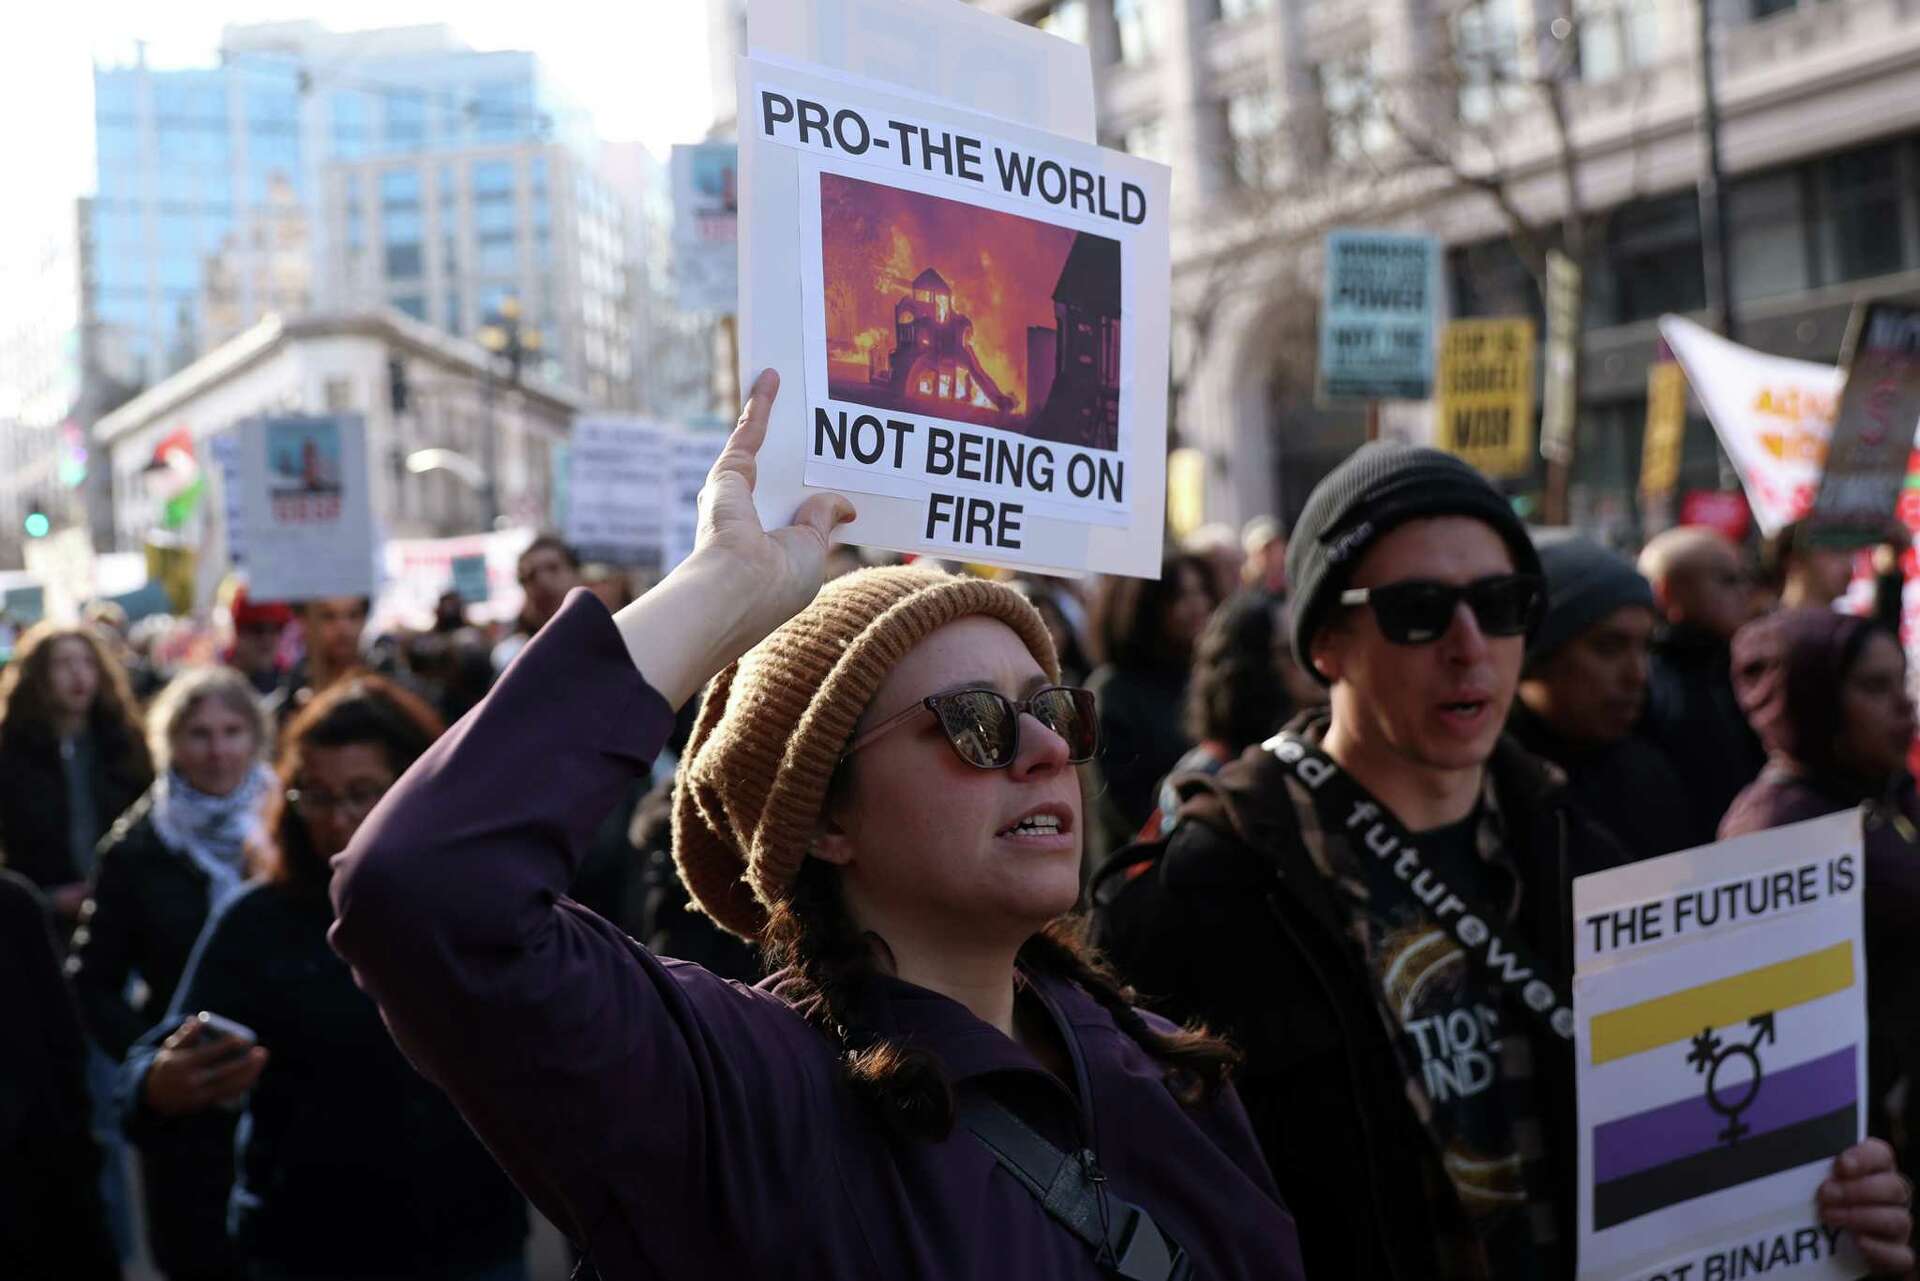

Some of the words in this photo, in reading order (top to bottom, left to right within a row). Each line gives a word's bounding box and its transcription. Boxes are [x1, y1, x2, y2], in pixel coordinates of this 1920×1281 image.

[761, 90, 985, 183] PRO-THE
[993, 149, 1147, 225] WORLD
[815, 408, 914, 470] NOT
[926, 429, 1054, 489] BEING
[1067, 453, 1124, 503] ON
[926, 493, 1024, 549] FIRE
[1588, 901, 1662, 952] THE
[1673, 864, 1818, 933] FUTURE
[1828, 854, 1856, 894] IS
[1703, 1226, 1844, 1281] BINARY
